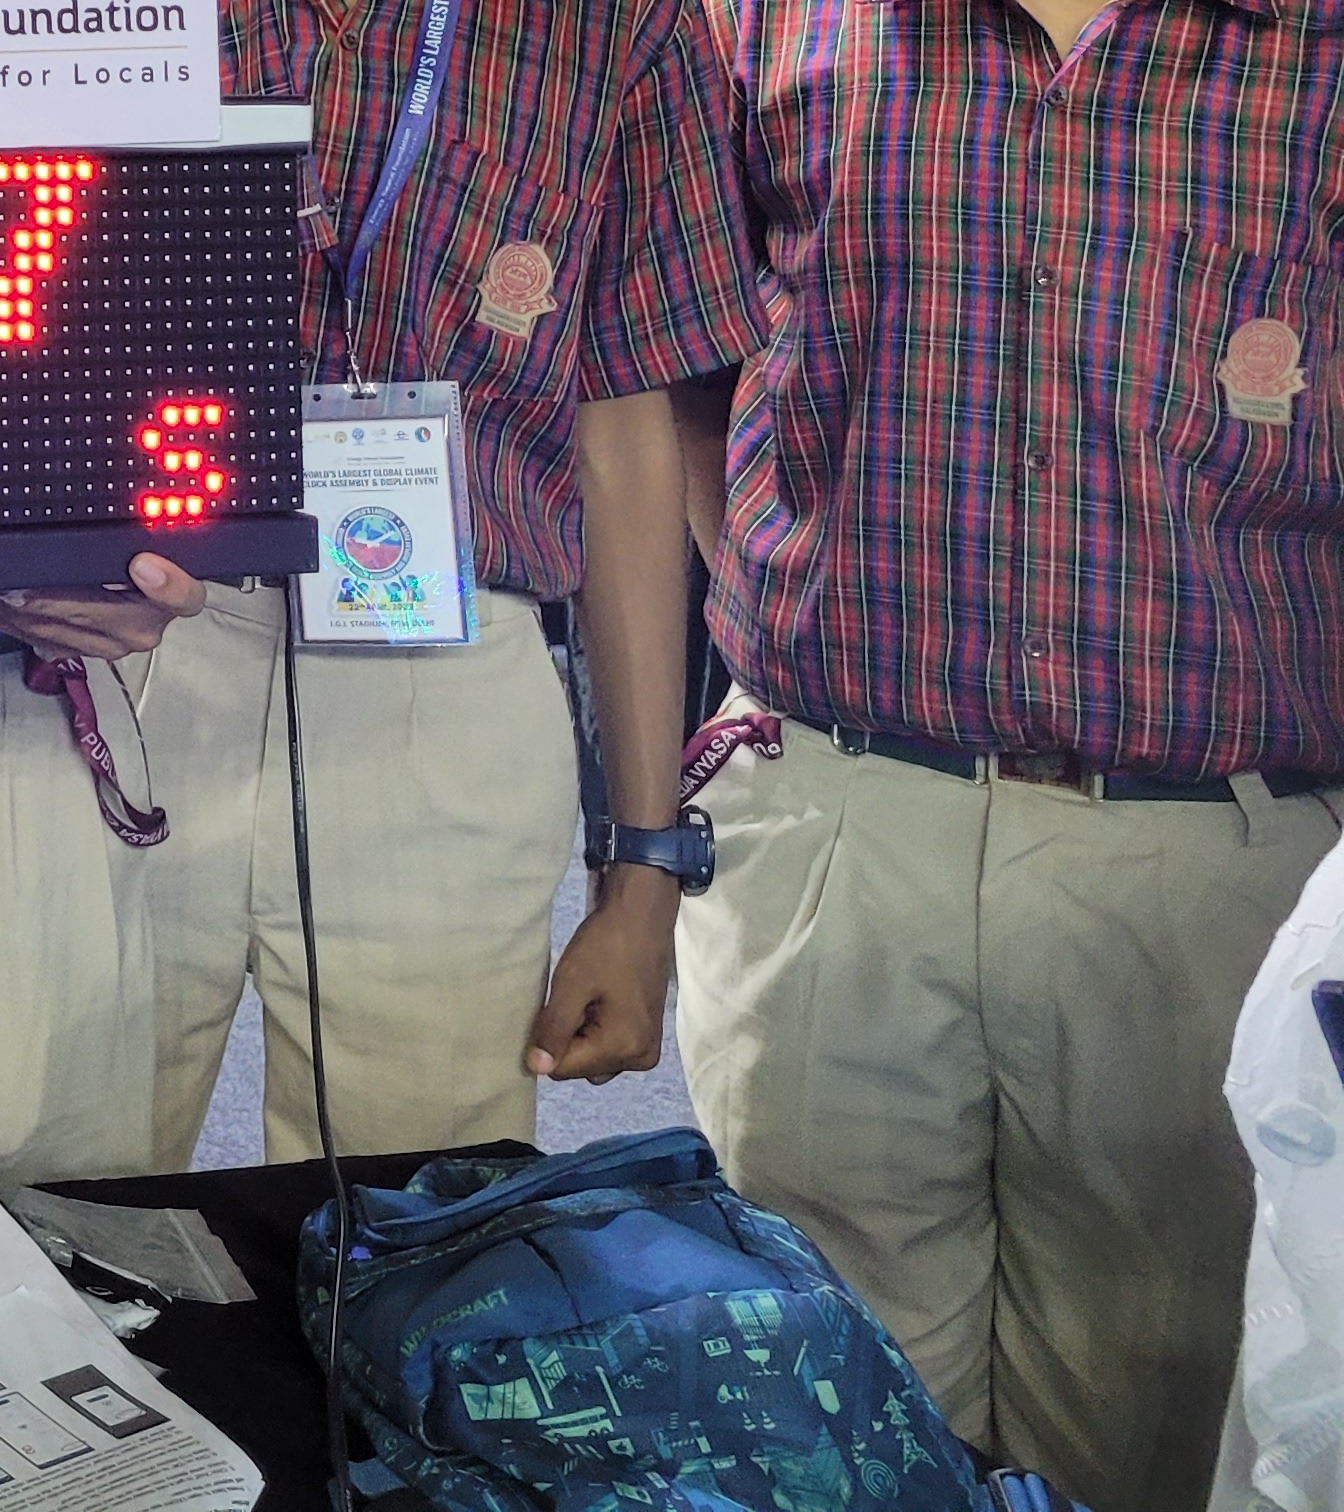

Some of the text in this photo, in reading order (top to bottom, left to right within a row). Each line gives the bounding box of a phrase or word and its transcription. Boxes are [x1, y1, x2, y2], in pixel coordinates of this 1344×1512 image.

[0, 65, 51, 87] for
[74, 61, 190, 85] Locals
[408, 55, 437, 116] WORLD'S
[138, 402, 226, 520] S
[373, 468, 402, 476] GLOBAL
[405, 467, 437, 476] CLIMATE
[415, 476, 439, 485] EVENT
